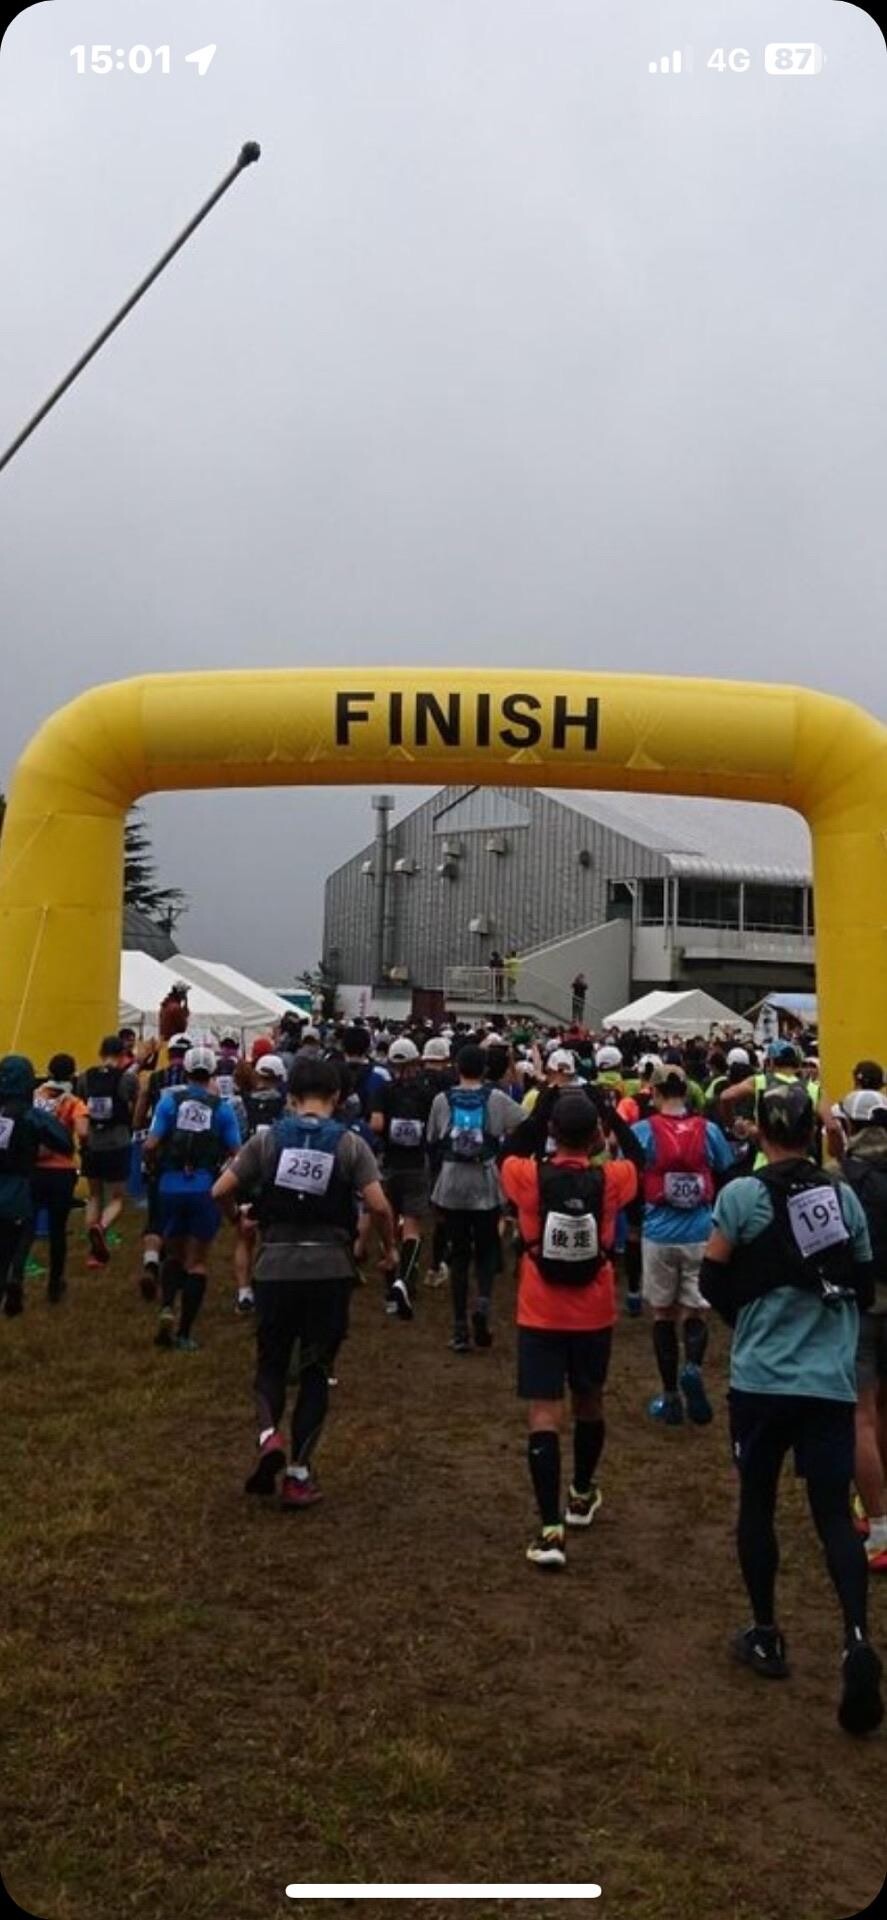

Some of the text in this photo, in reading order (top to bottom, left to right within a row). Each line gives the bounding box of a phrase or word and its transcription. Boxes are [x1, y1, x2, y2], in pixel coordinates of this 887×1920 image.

[335, 691, 600, 750] FINISH
[287, 1157, 323, 1180] 236
[672, 1182, 700, 1198] 204
